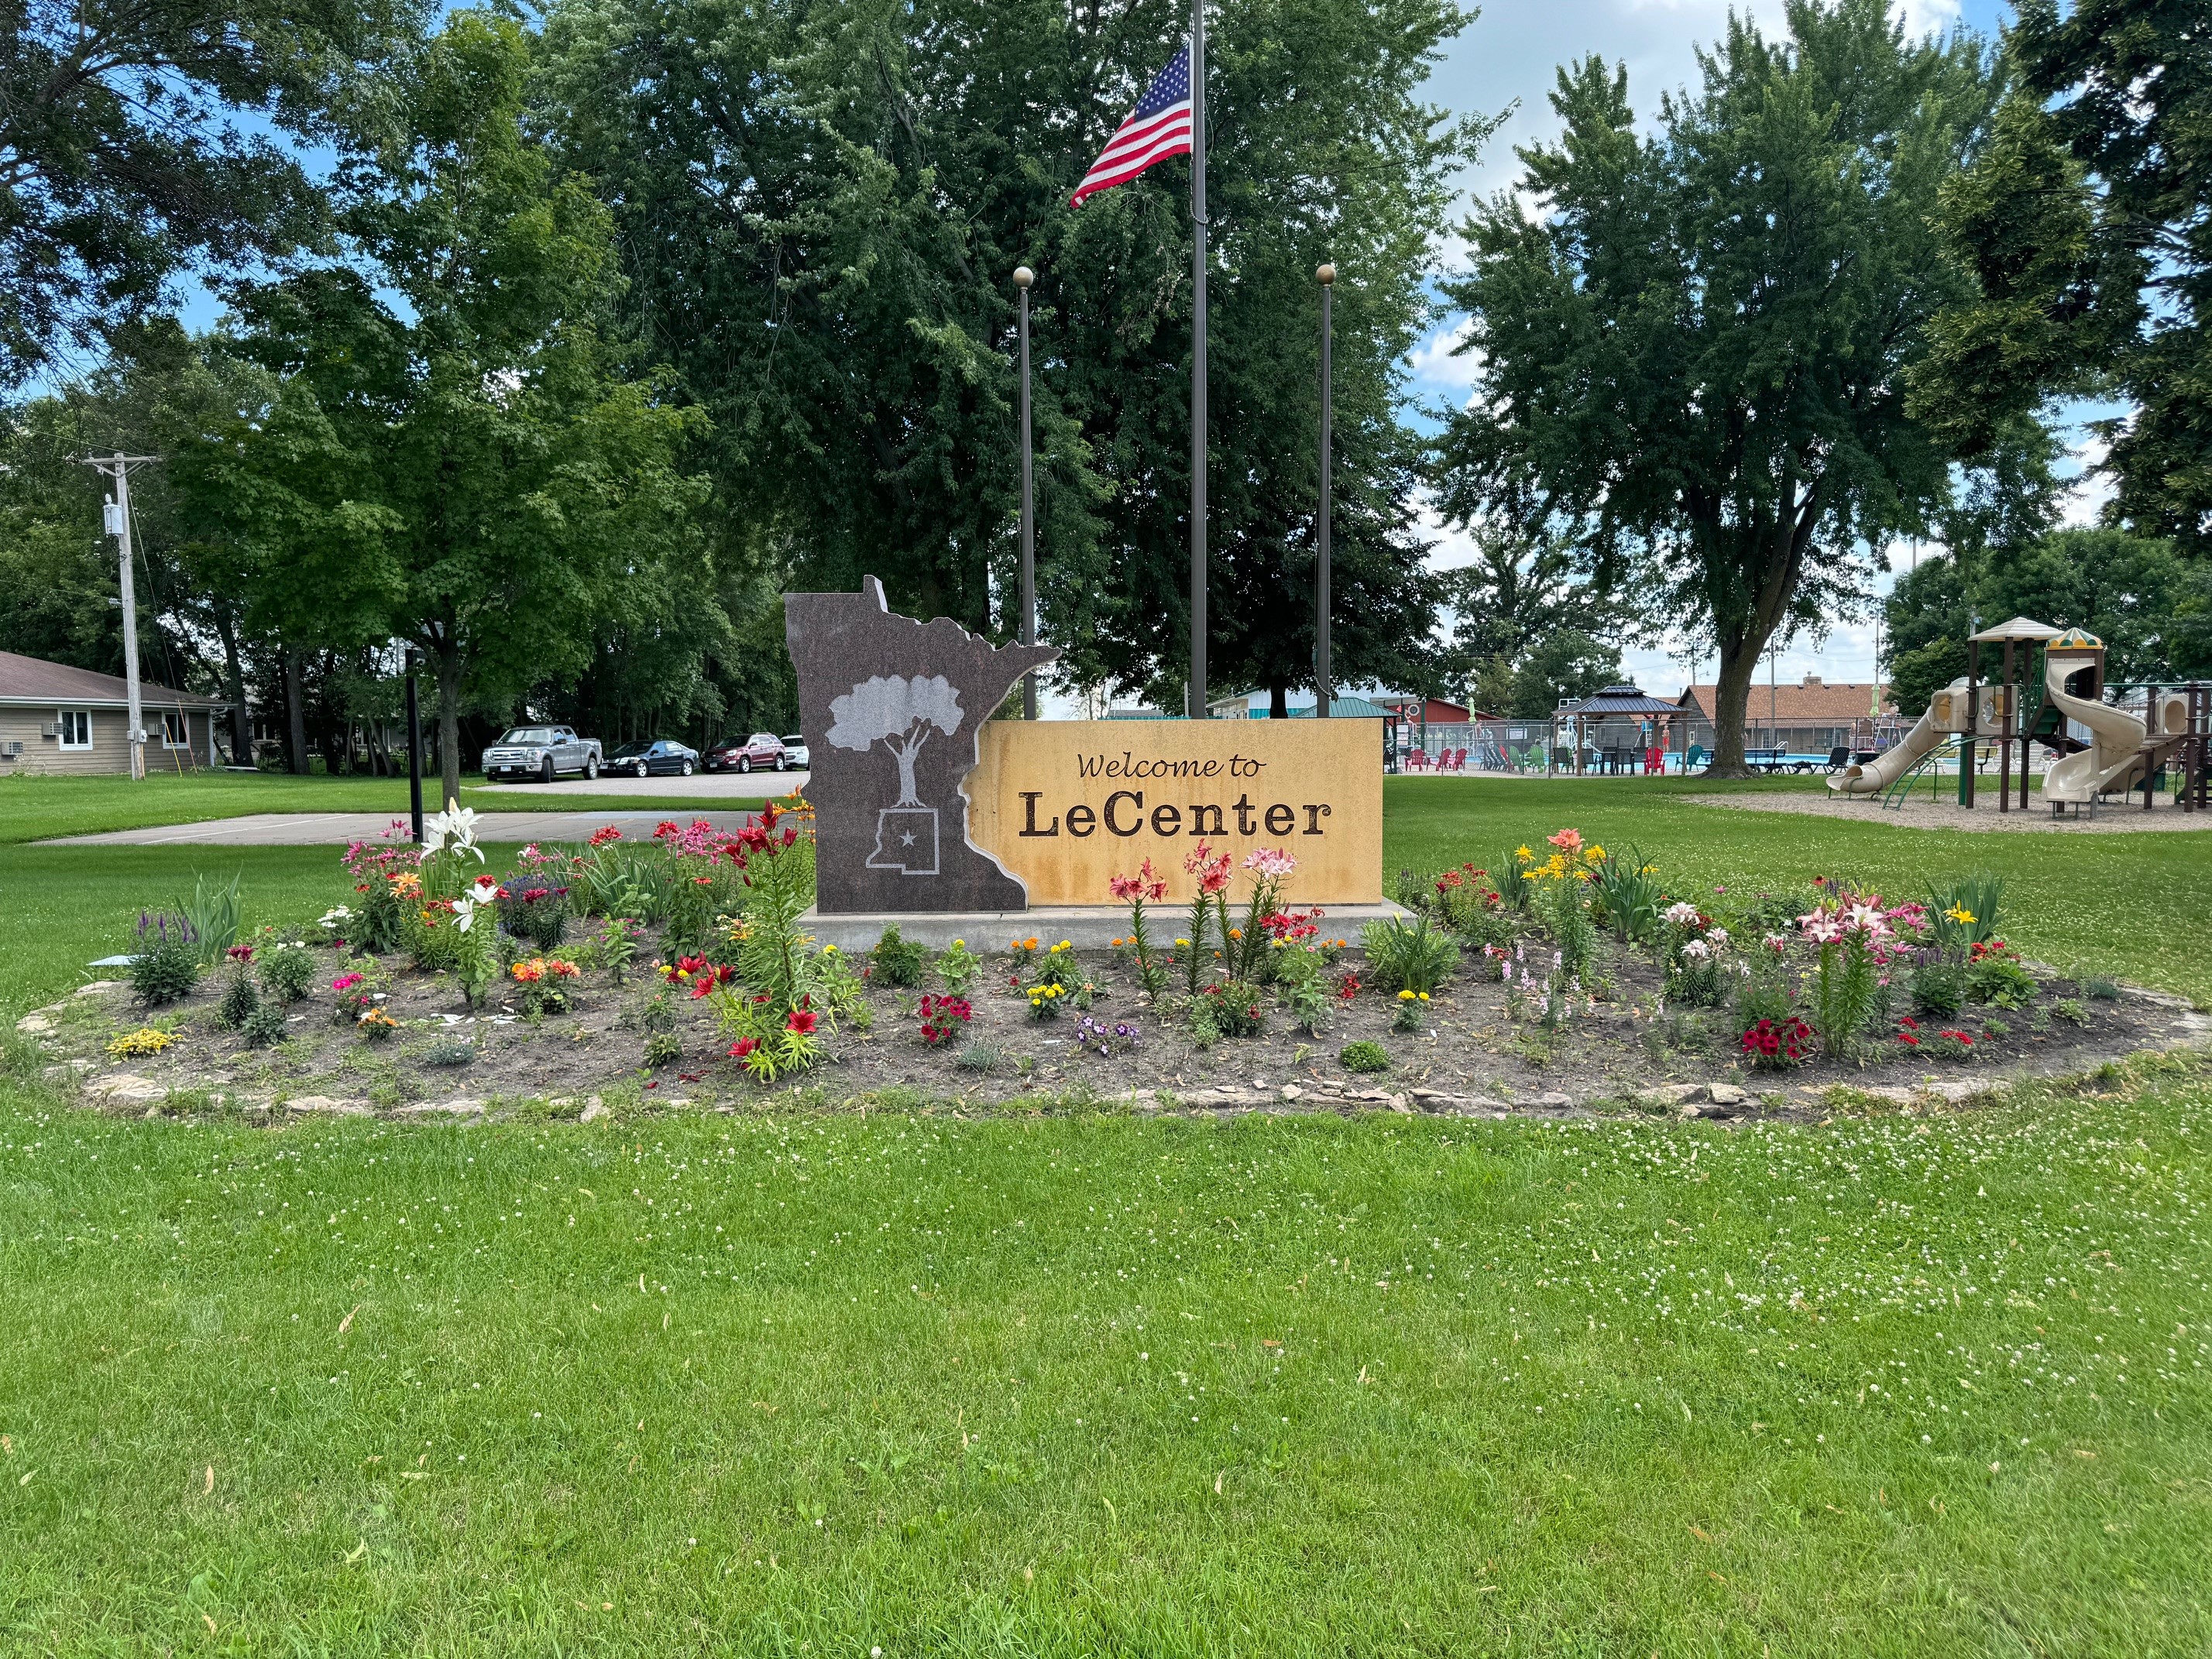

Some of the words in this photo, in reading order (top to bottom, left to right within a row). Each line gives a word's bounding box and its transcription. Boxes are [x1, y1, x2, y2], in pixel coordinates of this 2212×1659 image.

[1077, 751, 1224, 778] Welcome
[1228, 754, 1266, 777] to
[1018, 790, 1332, 837] LeCenter
